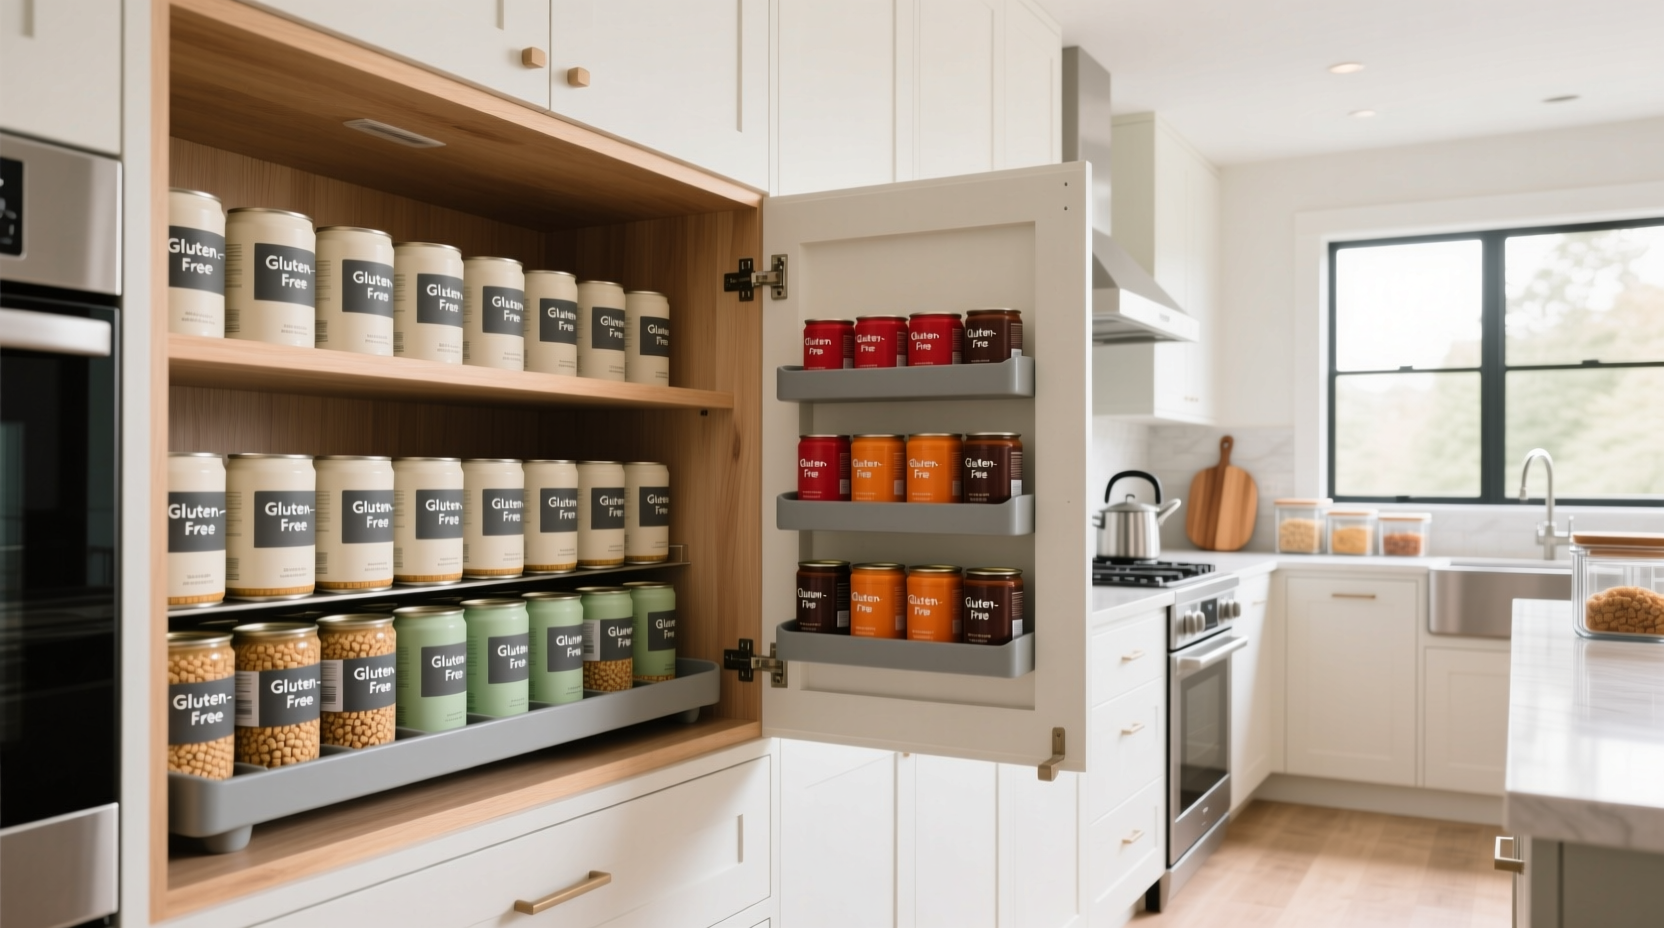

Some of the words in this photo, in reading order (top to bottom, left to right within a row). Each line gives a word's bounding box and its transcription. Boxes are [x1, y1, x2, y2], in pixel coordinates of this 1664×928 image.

[182, 258, 213, 275] Free
[281, 274, 307, 290] Free
[368, 287, 388, 302] Free
[281, 519, 307, 531] Free
[367, 516, 388, 528] Free
[439, 513, 459, 525] Free
[185, 522, 215, 535] Free
[271, 678, 320, 694] Gluten-
[370, 682, 391, 694] Free
[173, 692, 232, 710] Gluten-
[287, 695, 313, 708] Free
[191, 711, 224, 726] Free
